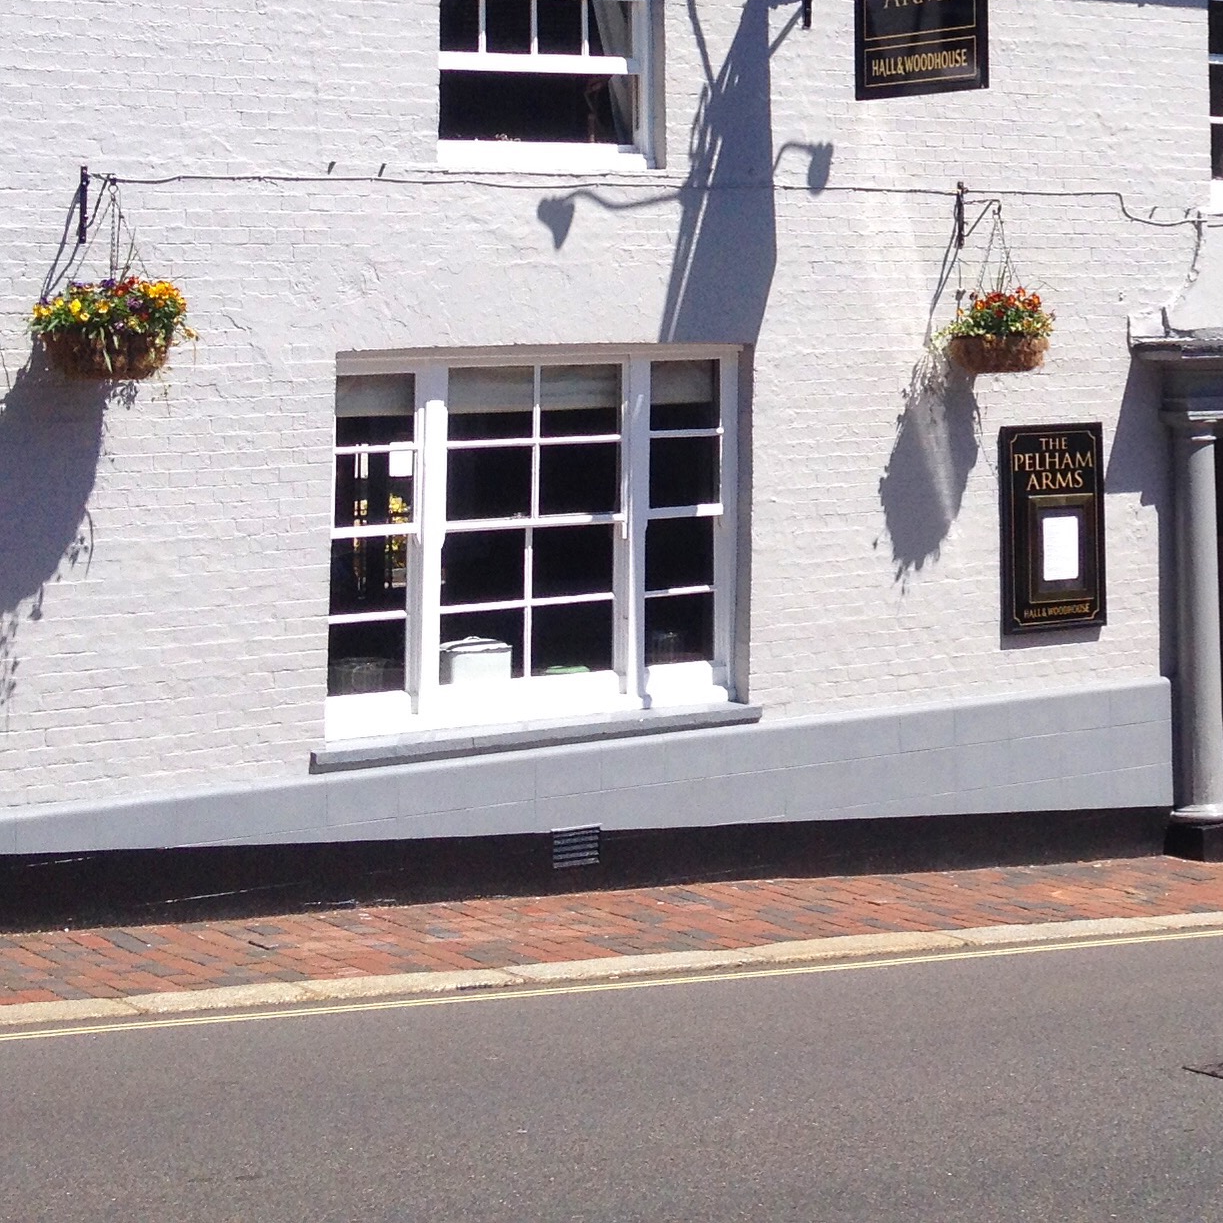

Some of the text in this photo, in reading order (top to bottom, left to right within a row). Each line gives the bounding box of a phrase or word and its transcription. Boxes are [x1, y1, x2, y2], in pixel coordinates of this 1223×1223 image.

[1039, 437, 1068, 450] THE
[1014, 451, 1093, 472] PELHAM
[1026, 469, 1084, 491] ARMS
